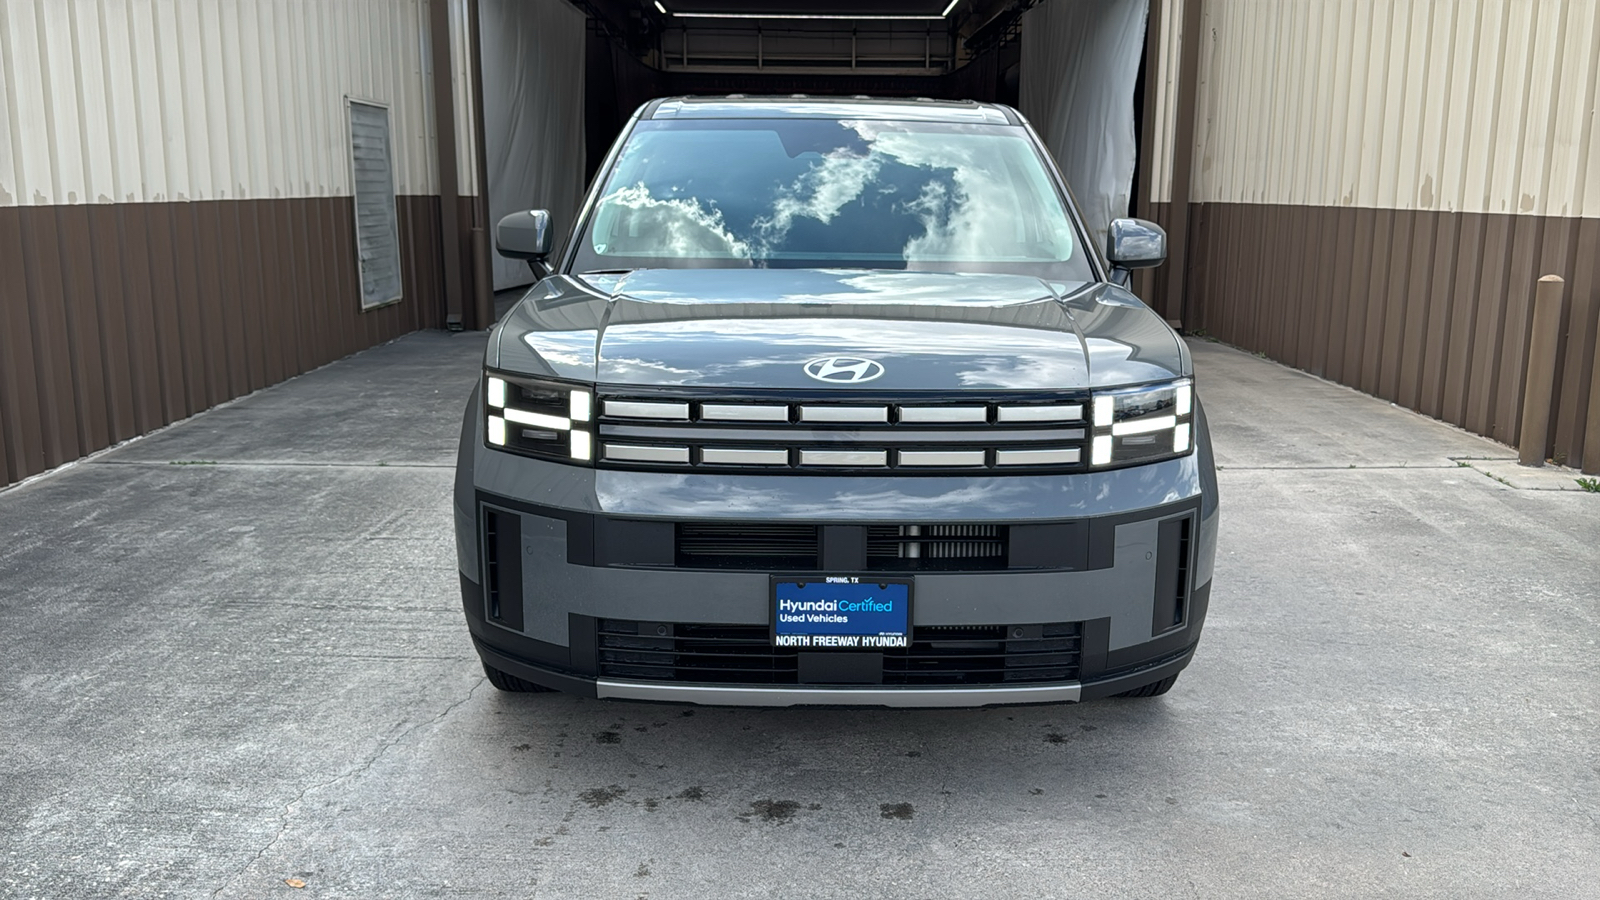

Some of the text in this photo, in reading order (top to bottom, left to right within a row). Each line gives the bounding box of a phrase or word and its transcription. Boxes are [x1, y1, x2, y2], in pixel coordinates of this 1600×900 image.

[780, 597, 892, 613] Hyundai Certified
[780, 614, 848, 623] Used Vehicles
[776, 635, 907, 647] NORTH FREEWAY HYUNDAI
